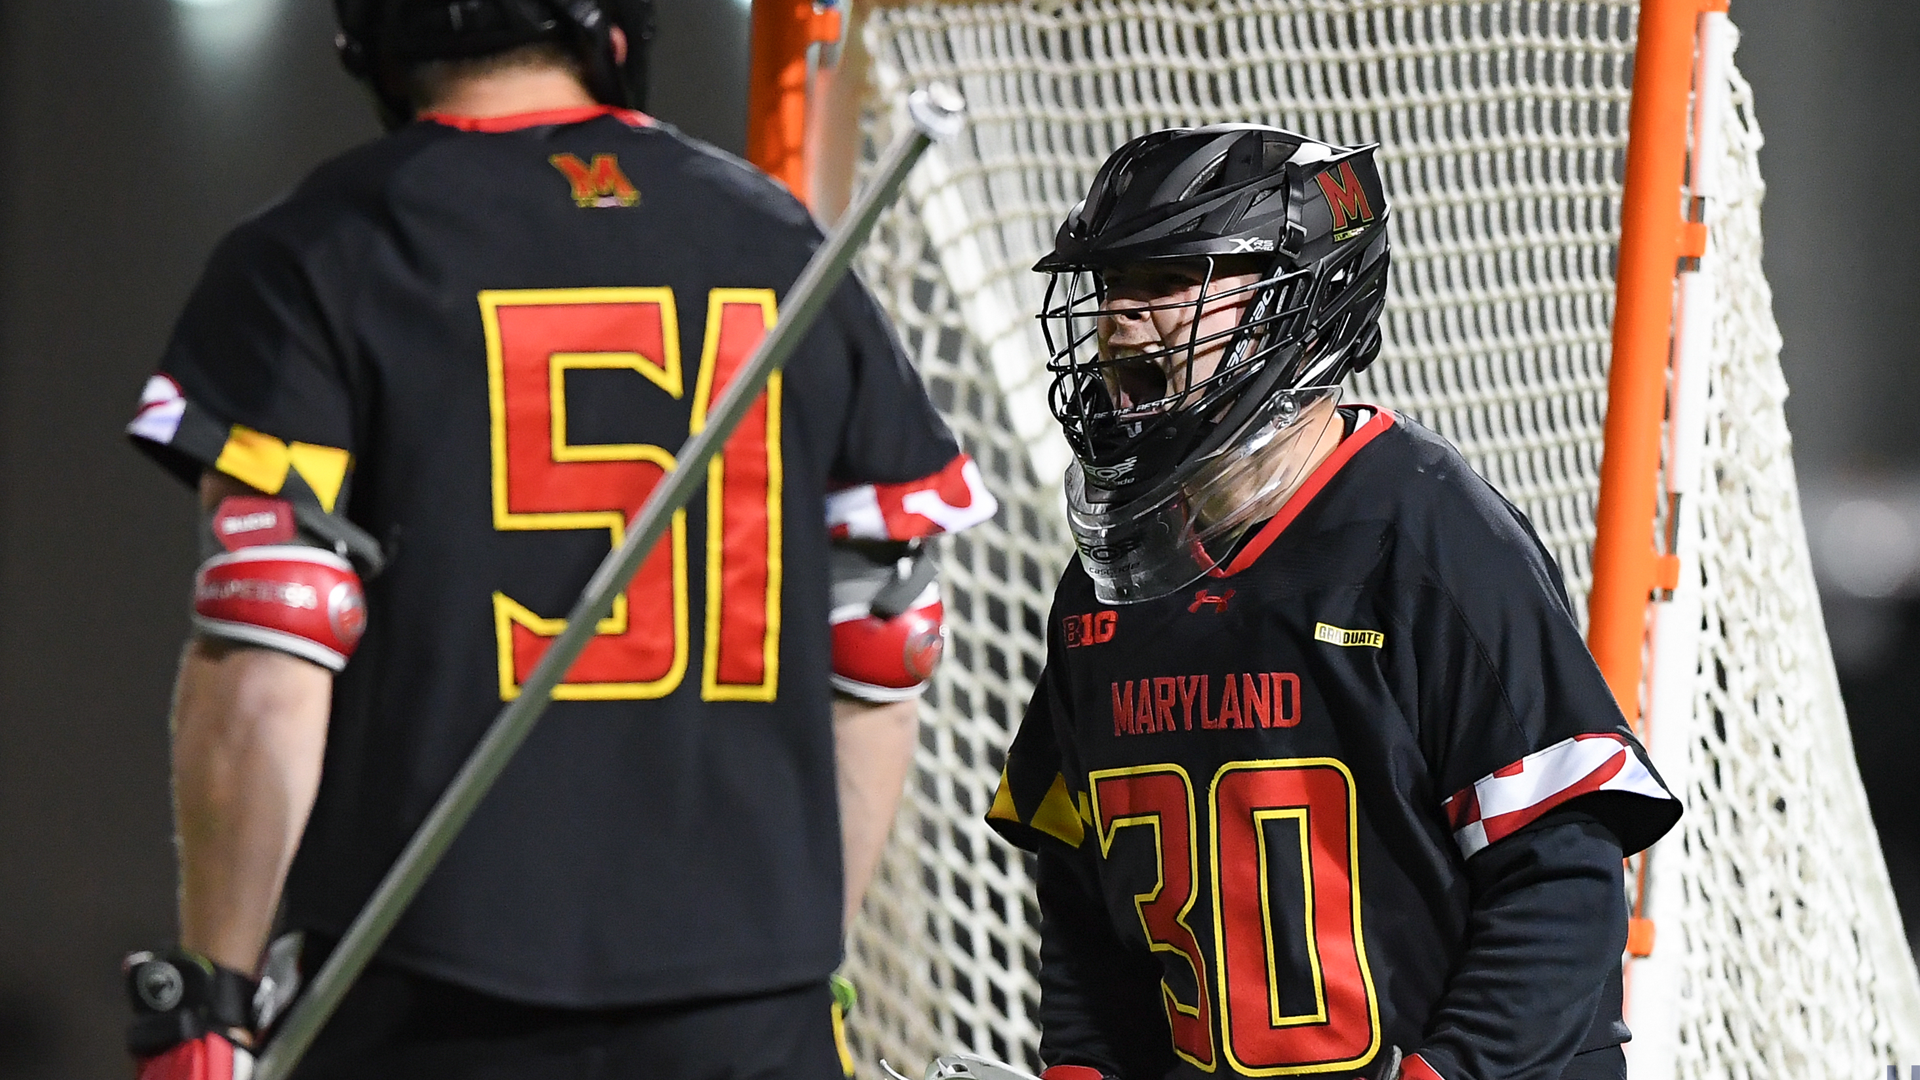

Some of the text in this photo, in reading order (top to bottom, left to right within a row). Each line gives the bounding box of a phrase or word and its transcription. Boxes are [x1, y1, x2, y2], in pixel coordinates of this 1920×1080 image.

[548, 152, 641, 201] M
[1314, 161, 1374, 232] M
[478, 286, 782, 702] 51
[1319, 625, 1381, 645] GRADUATE
[1111, 672, 1301, 736] MARYLAND
[1089, 757, 1380, 1077] 30
